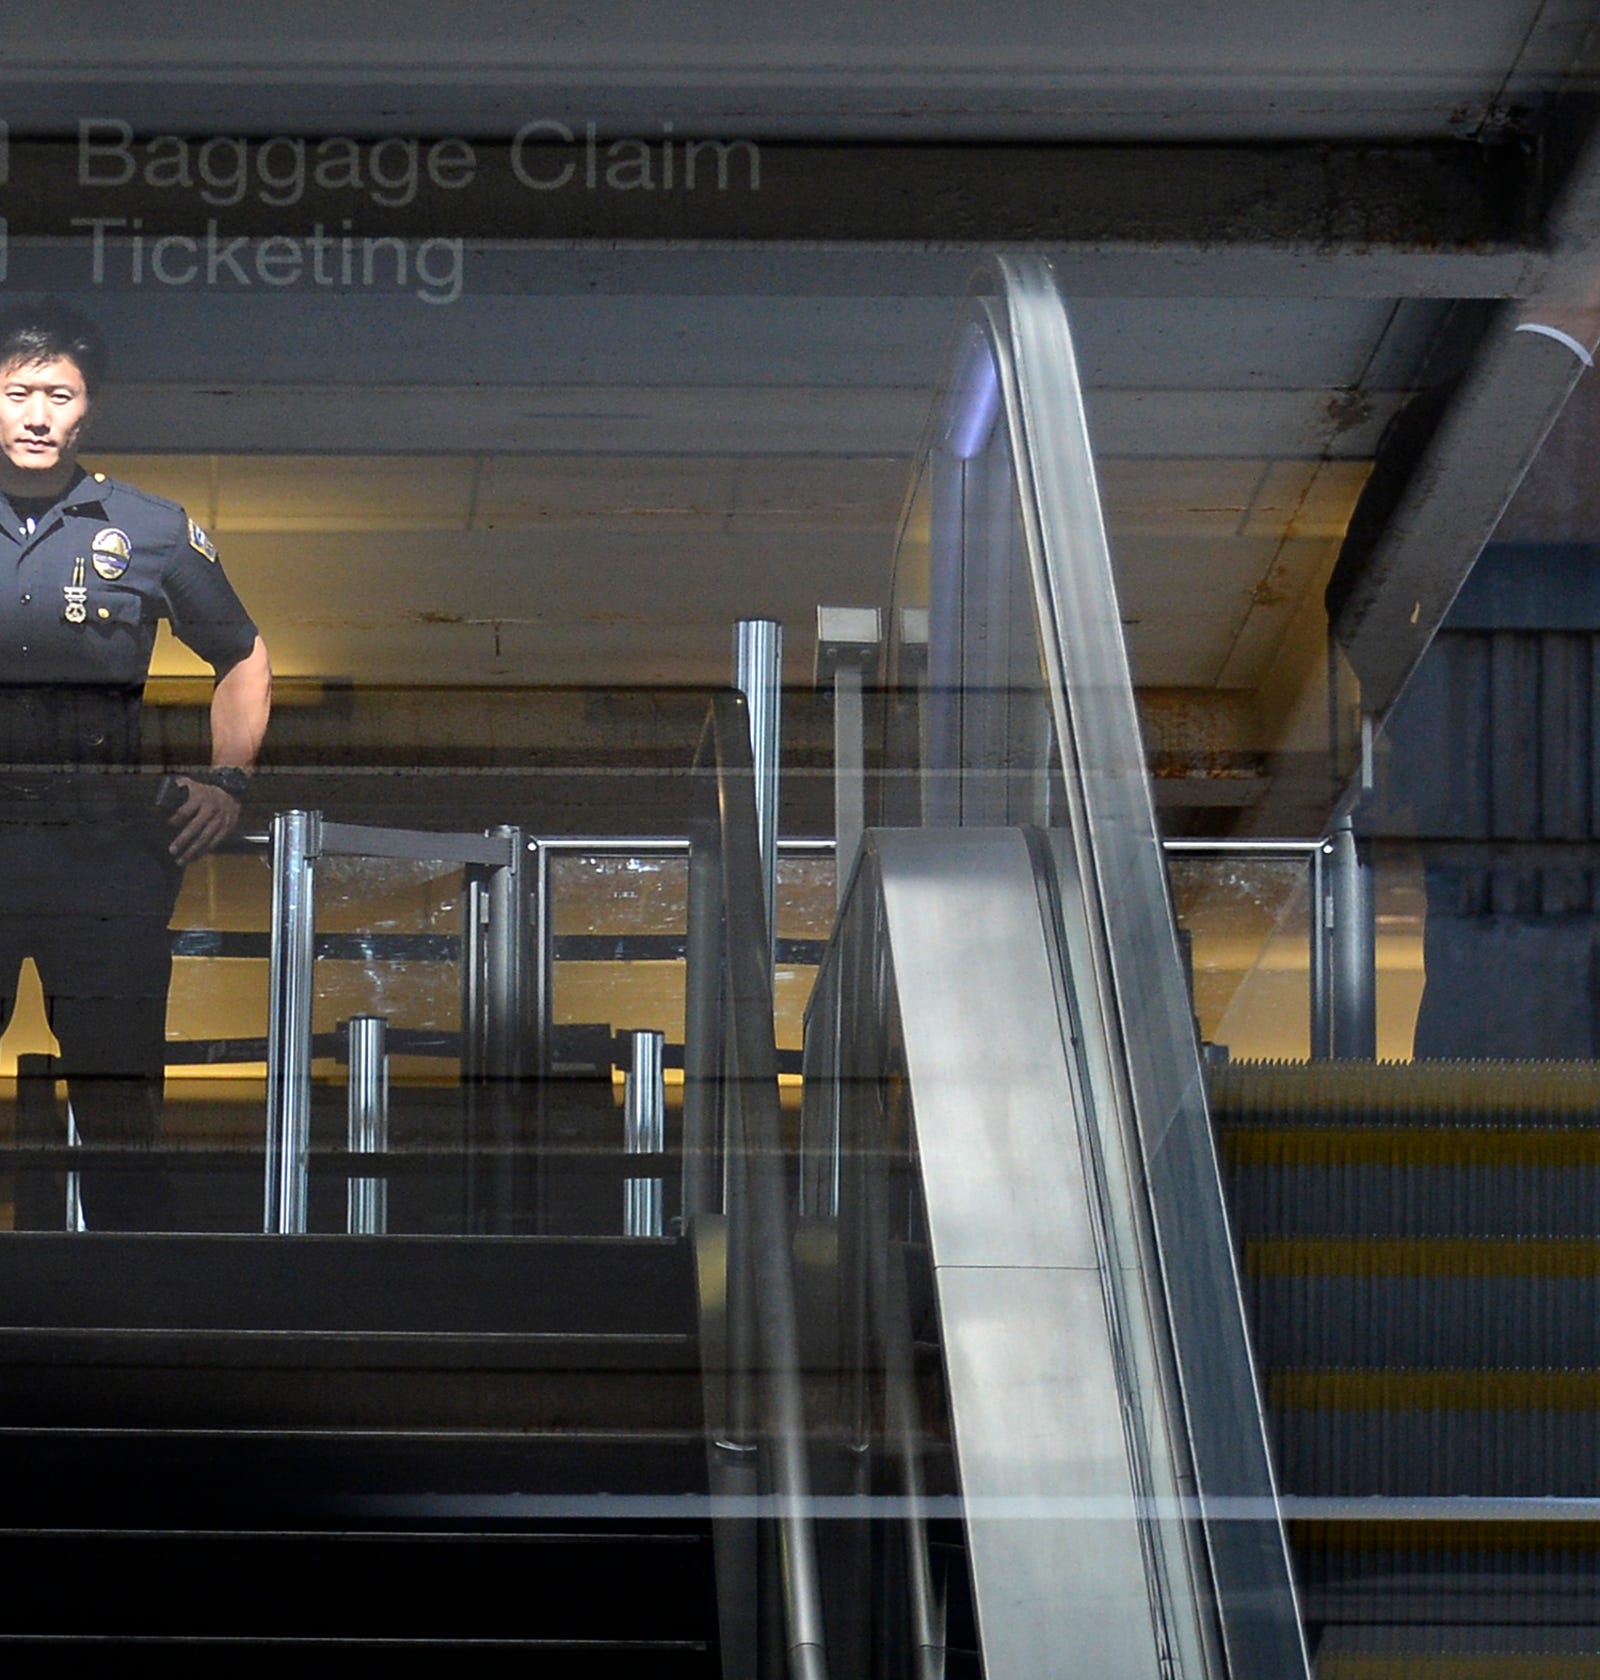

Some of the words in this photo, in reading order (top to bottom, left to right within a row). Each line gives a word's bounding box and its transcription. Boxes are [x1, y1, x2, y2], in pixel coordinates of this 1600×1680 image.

[76, 117, 478, 206] Baggage
[510, 119, 761, 190] Claim
[69, 216, 464, 305] Ticketing
